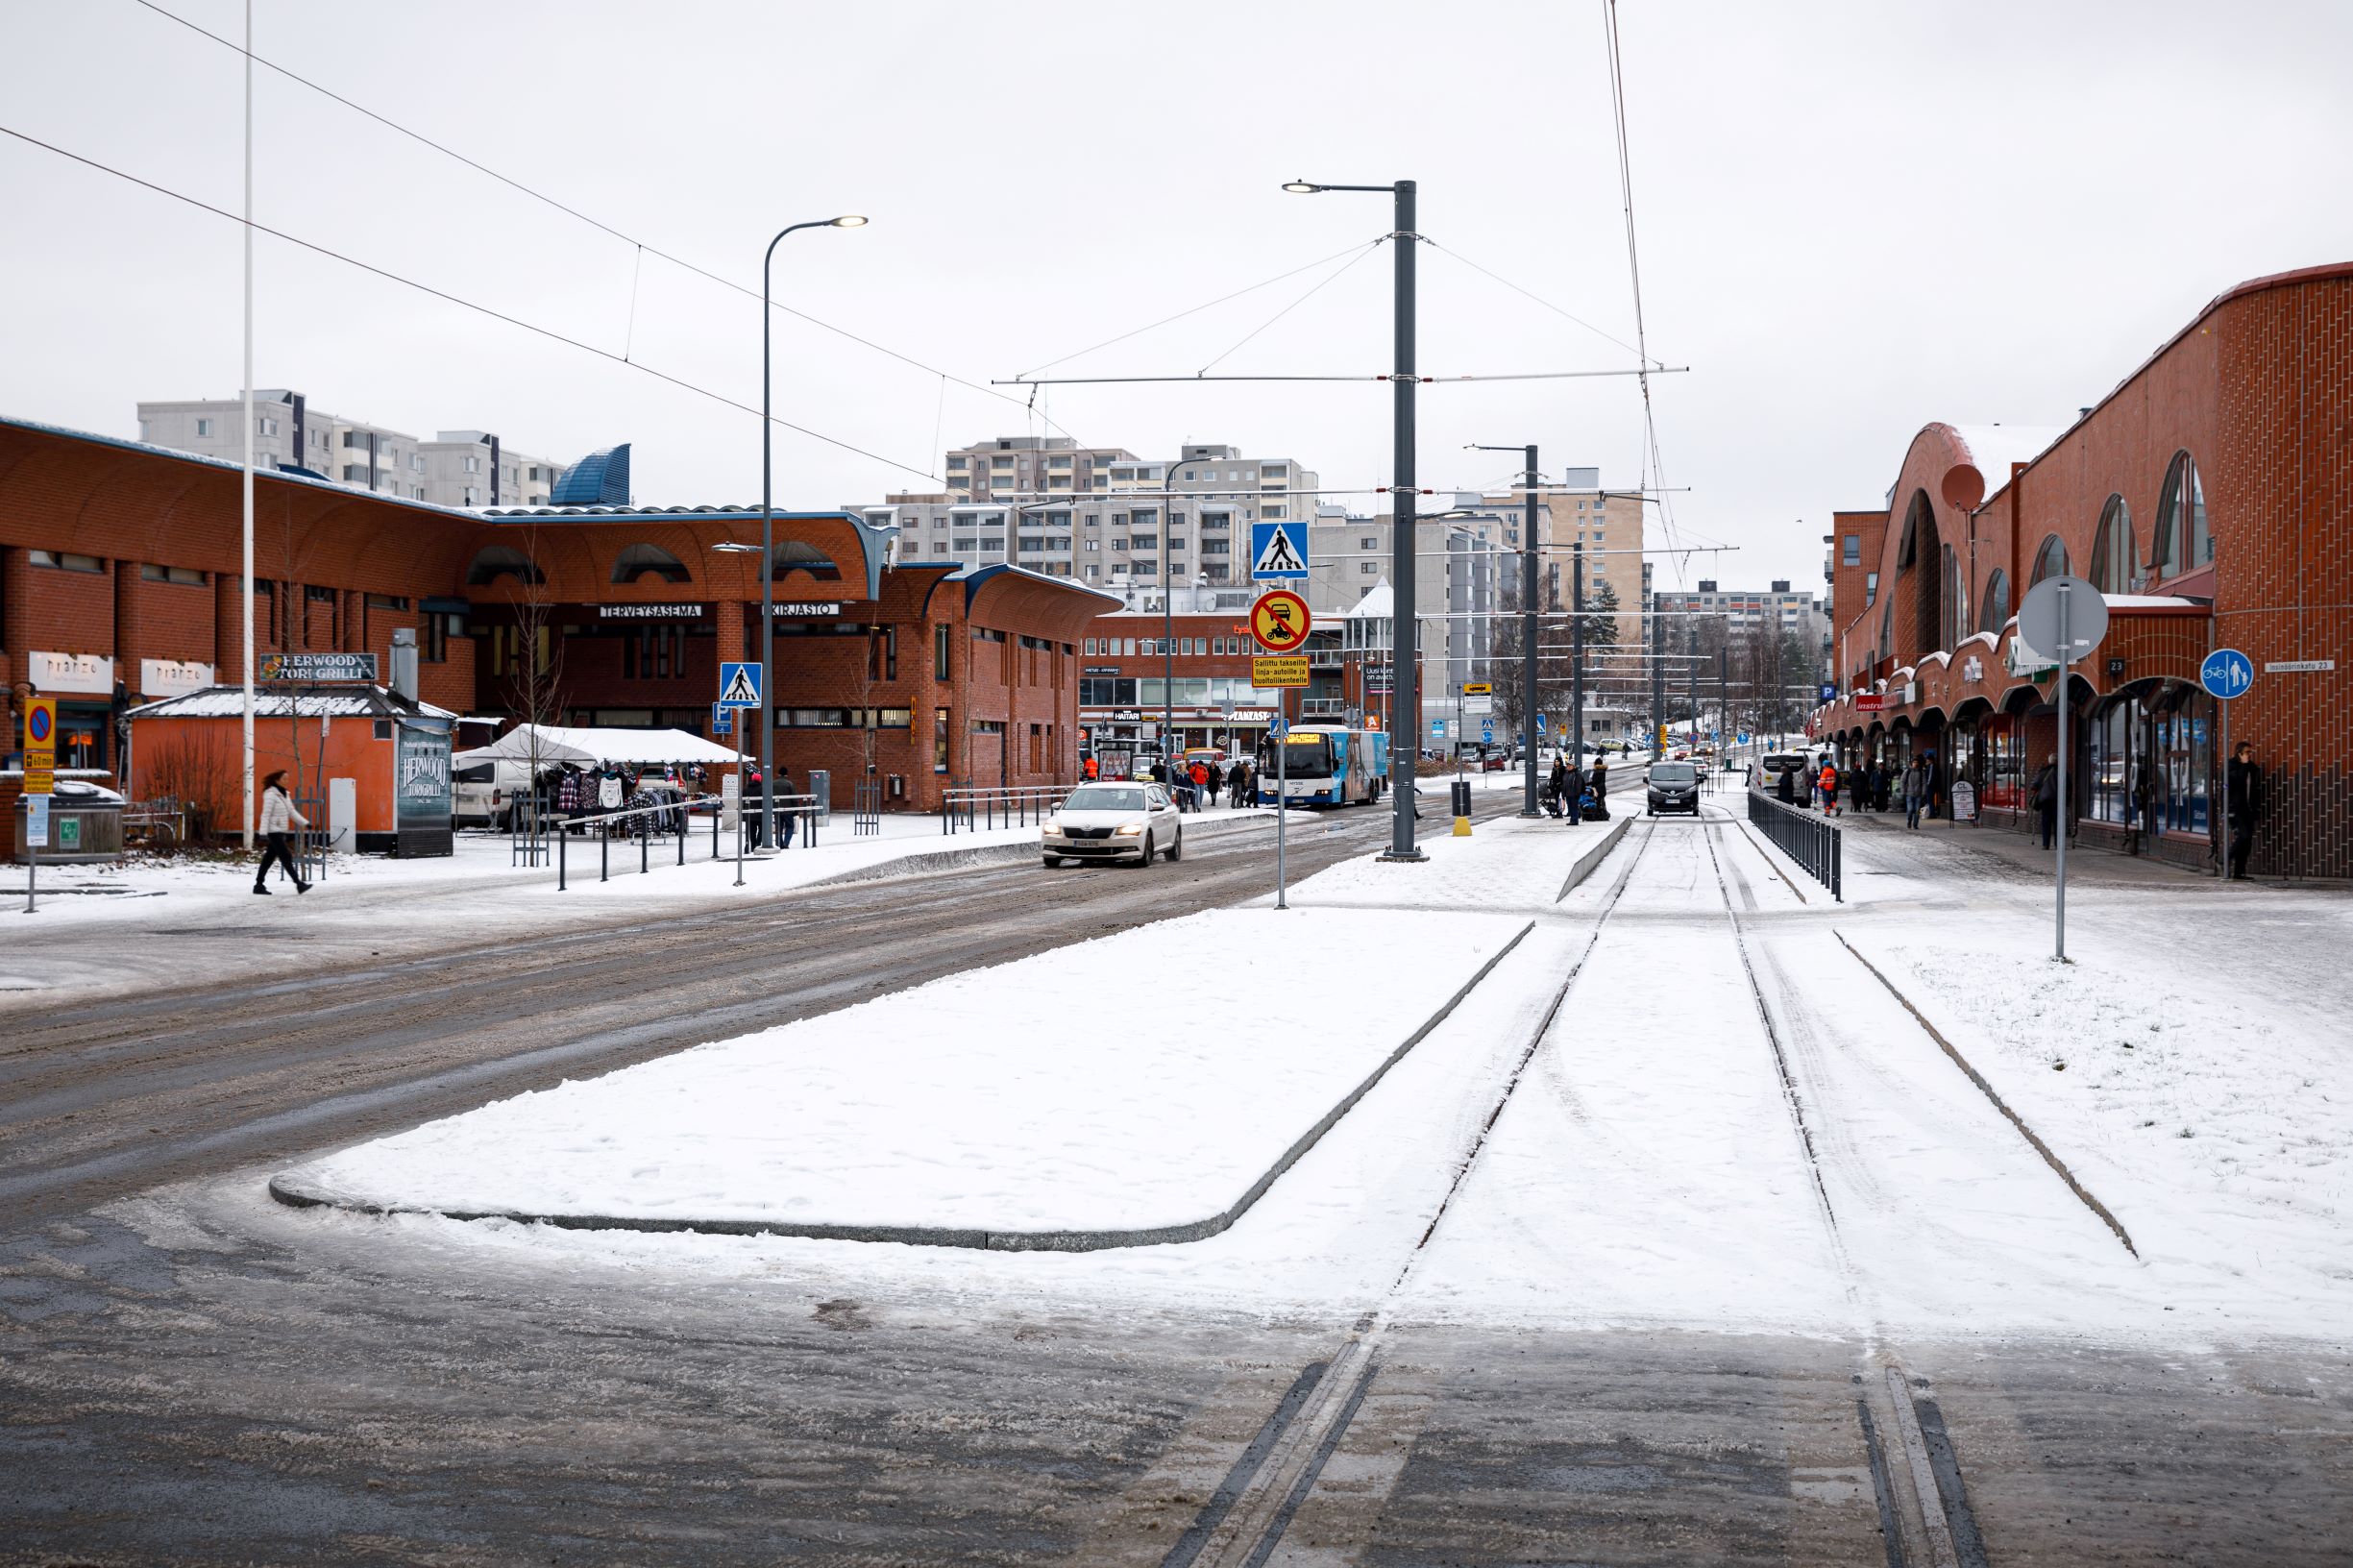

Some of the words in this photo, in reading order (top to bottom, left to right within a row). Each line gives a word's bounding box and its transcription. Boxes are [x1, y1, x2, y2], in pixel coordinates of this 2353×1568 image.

[603, 606, 699, 617] TERVEYSASEMA
[771, 604, 831, 616] KIRJASTO
[282, 655, 356, 666] HERWOOD
[2110, 661, 2122, 670] 23
[315, 668, 362, 679] GRILLI
[404, 757, 447, 787] HERWOOD
